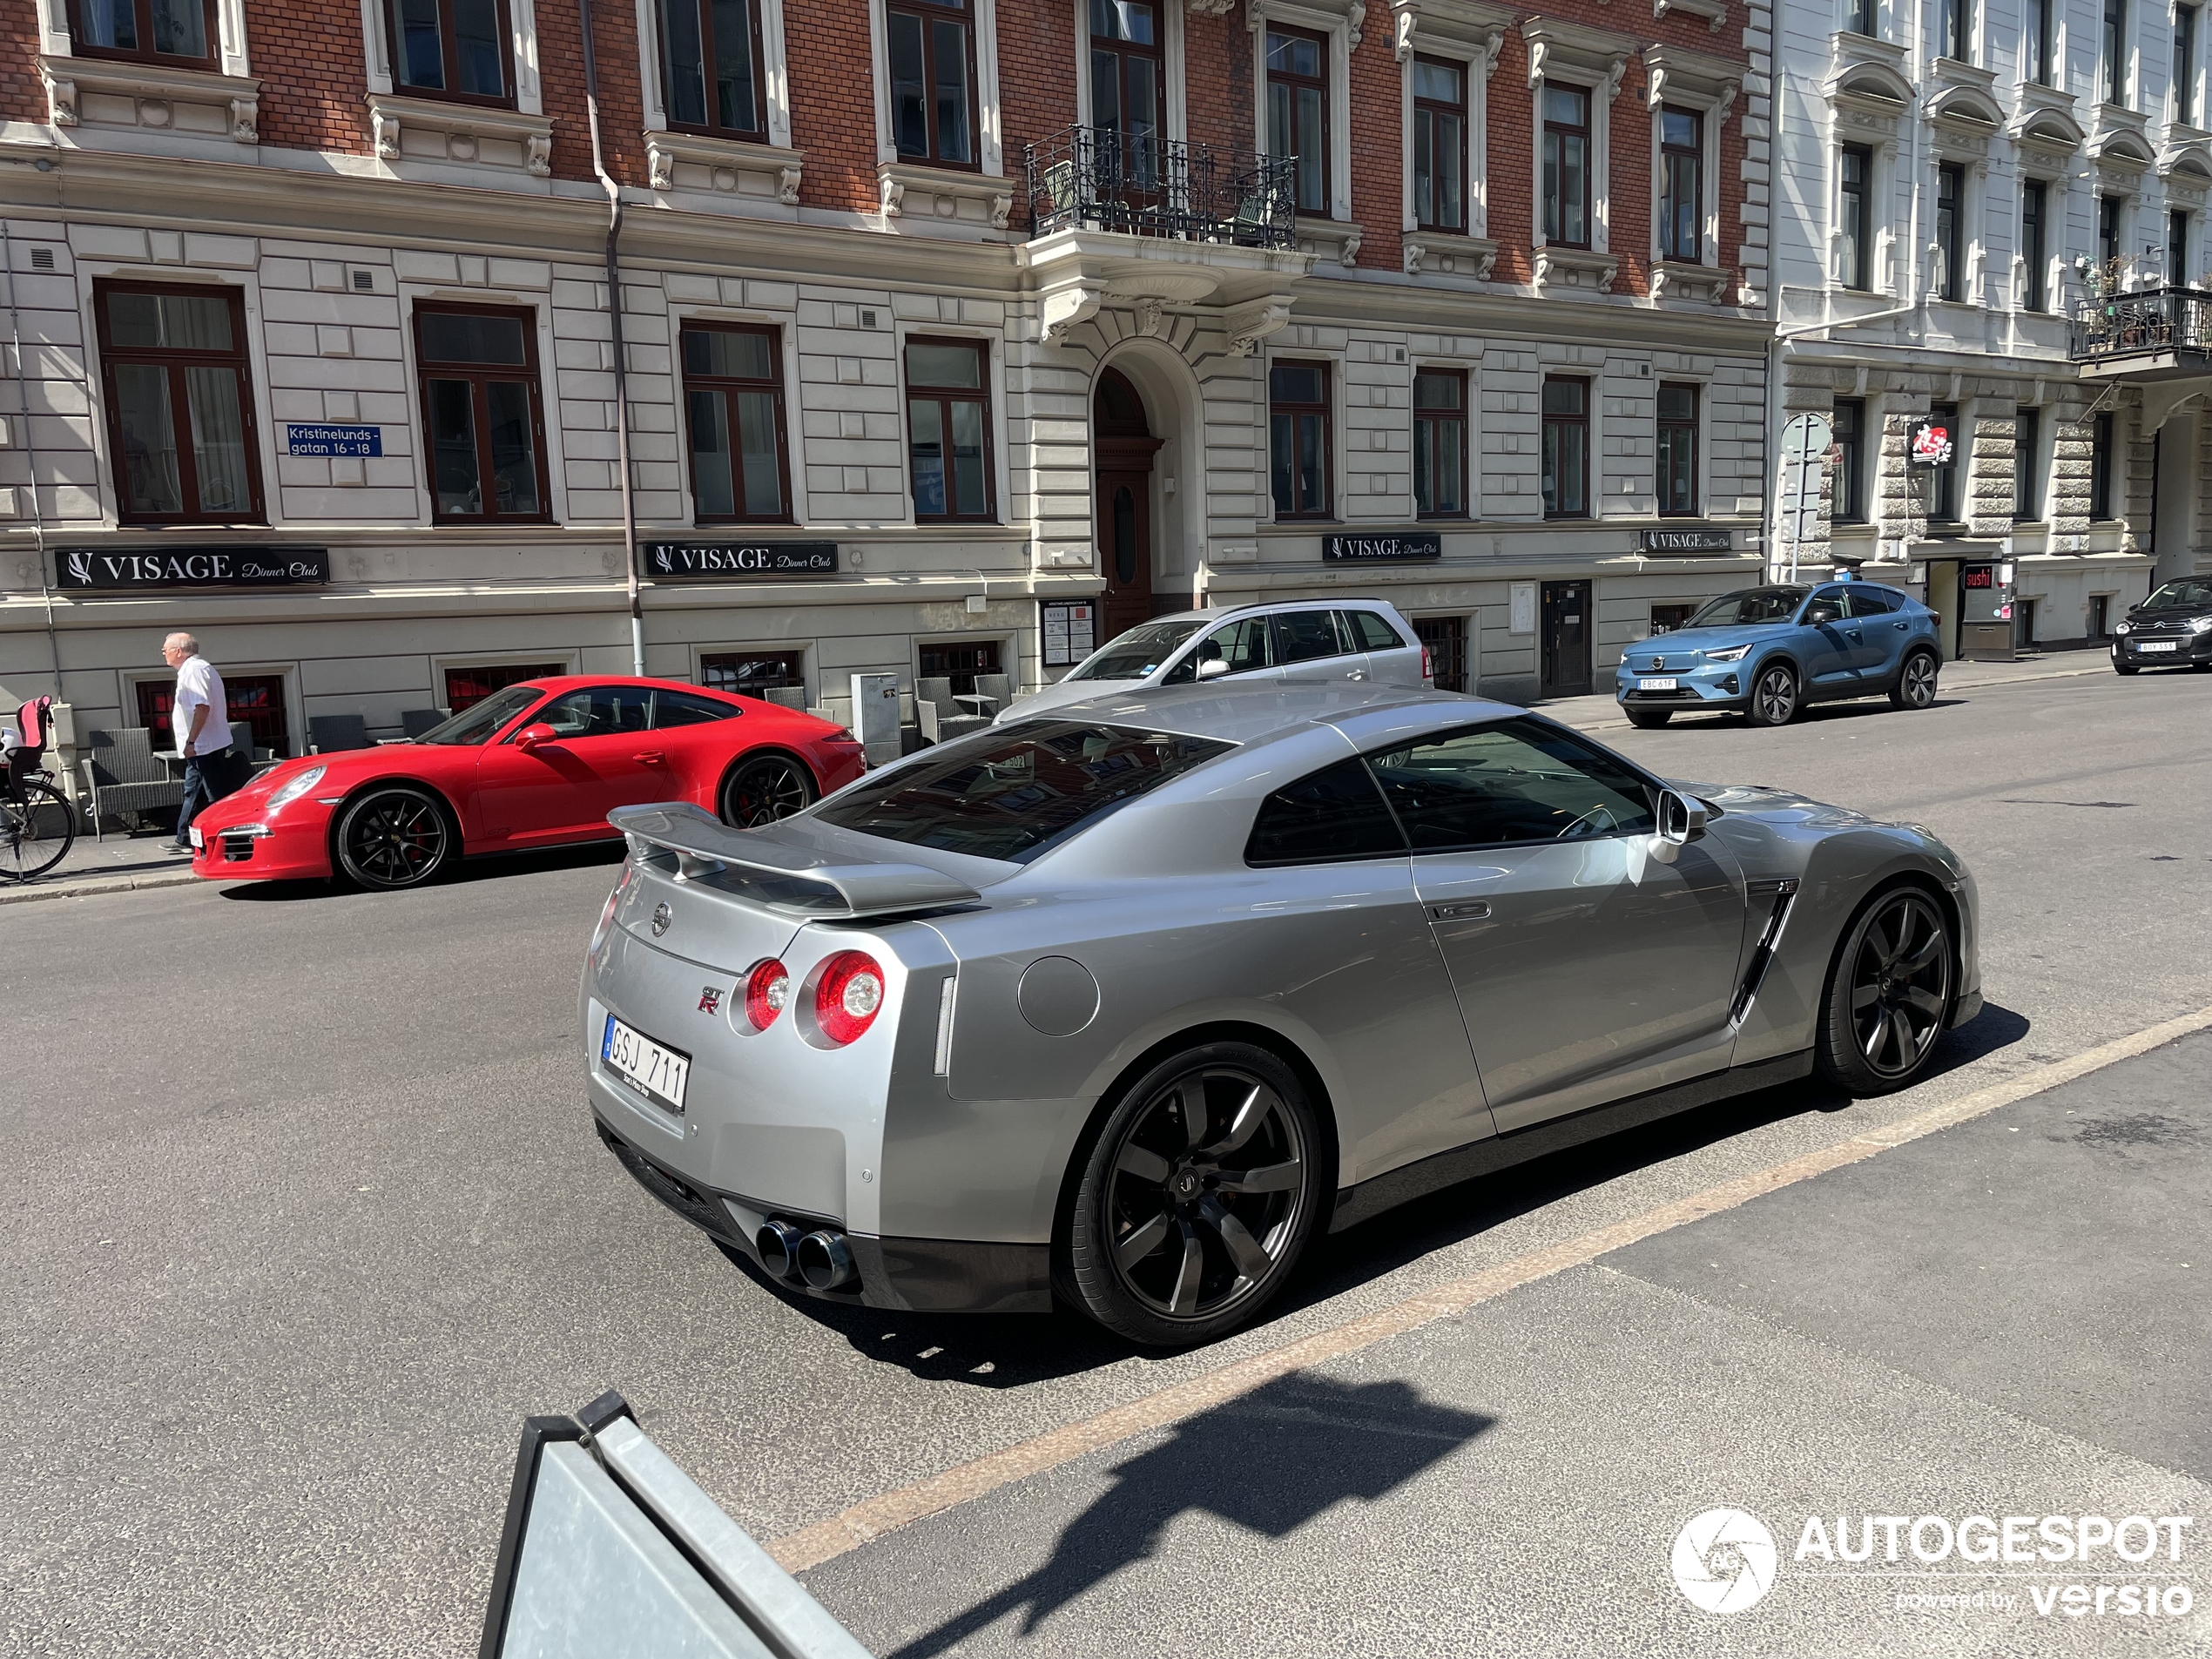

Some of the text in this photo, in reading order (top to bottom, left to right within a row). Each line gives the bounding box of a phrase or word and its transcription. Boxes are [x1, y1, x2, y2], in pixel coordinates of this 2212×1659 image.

[289, 428, 379, 441] Kristinelunds-
[292, 442, 370, 455] gatan 16-18
[1346, 539, 1401, 556] VISAGE
[1423, 543, 1437, 555] Club
[1661, 533, 1702, 548] VISAGE
[101, 555, 233, 581] VISAGE
[241, 562, 286, 578] Dinner
[289, 561, 319, 577] Club
[679, 549, 772, 570] VISAGE
[777, 555, 808, 569] Dinner
[810, 555, 831, 568] Club
[1966, 569, 1990, 586] sushi
[606, 1042, 610, 1052] S
[612, 1027, 681, 1099] GSJ 711
